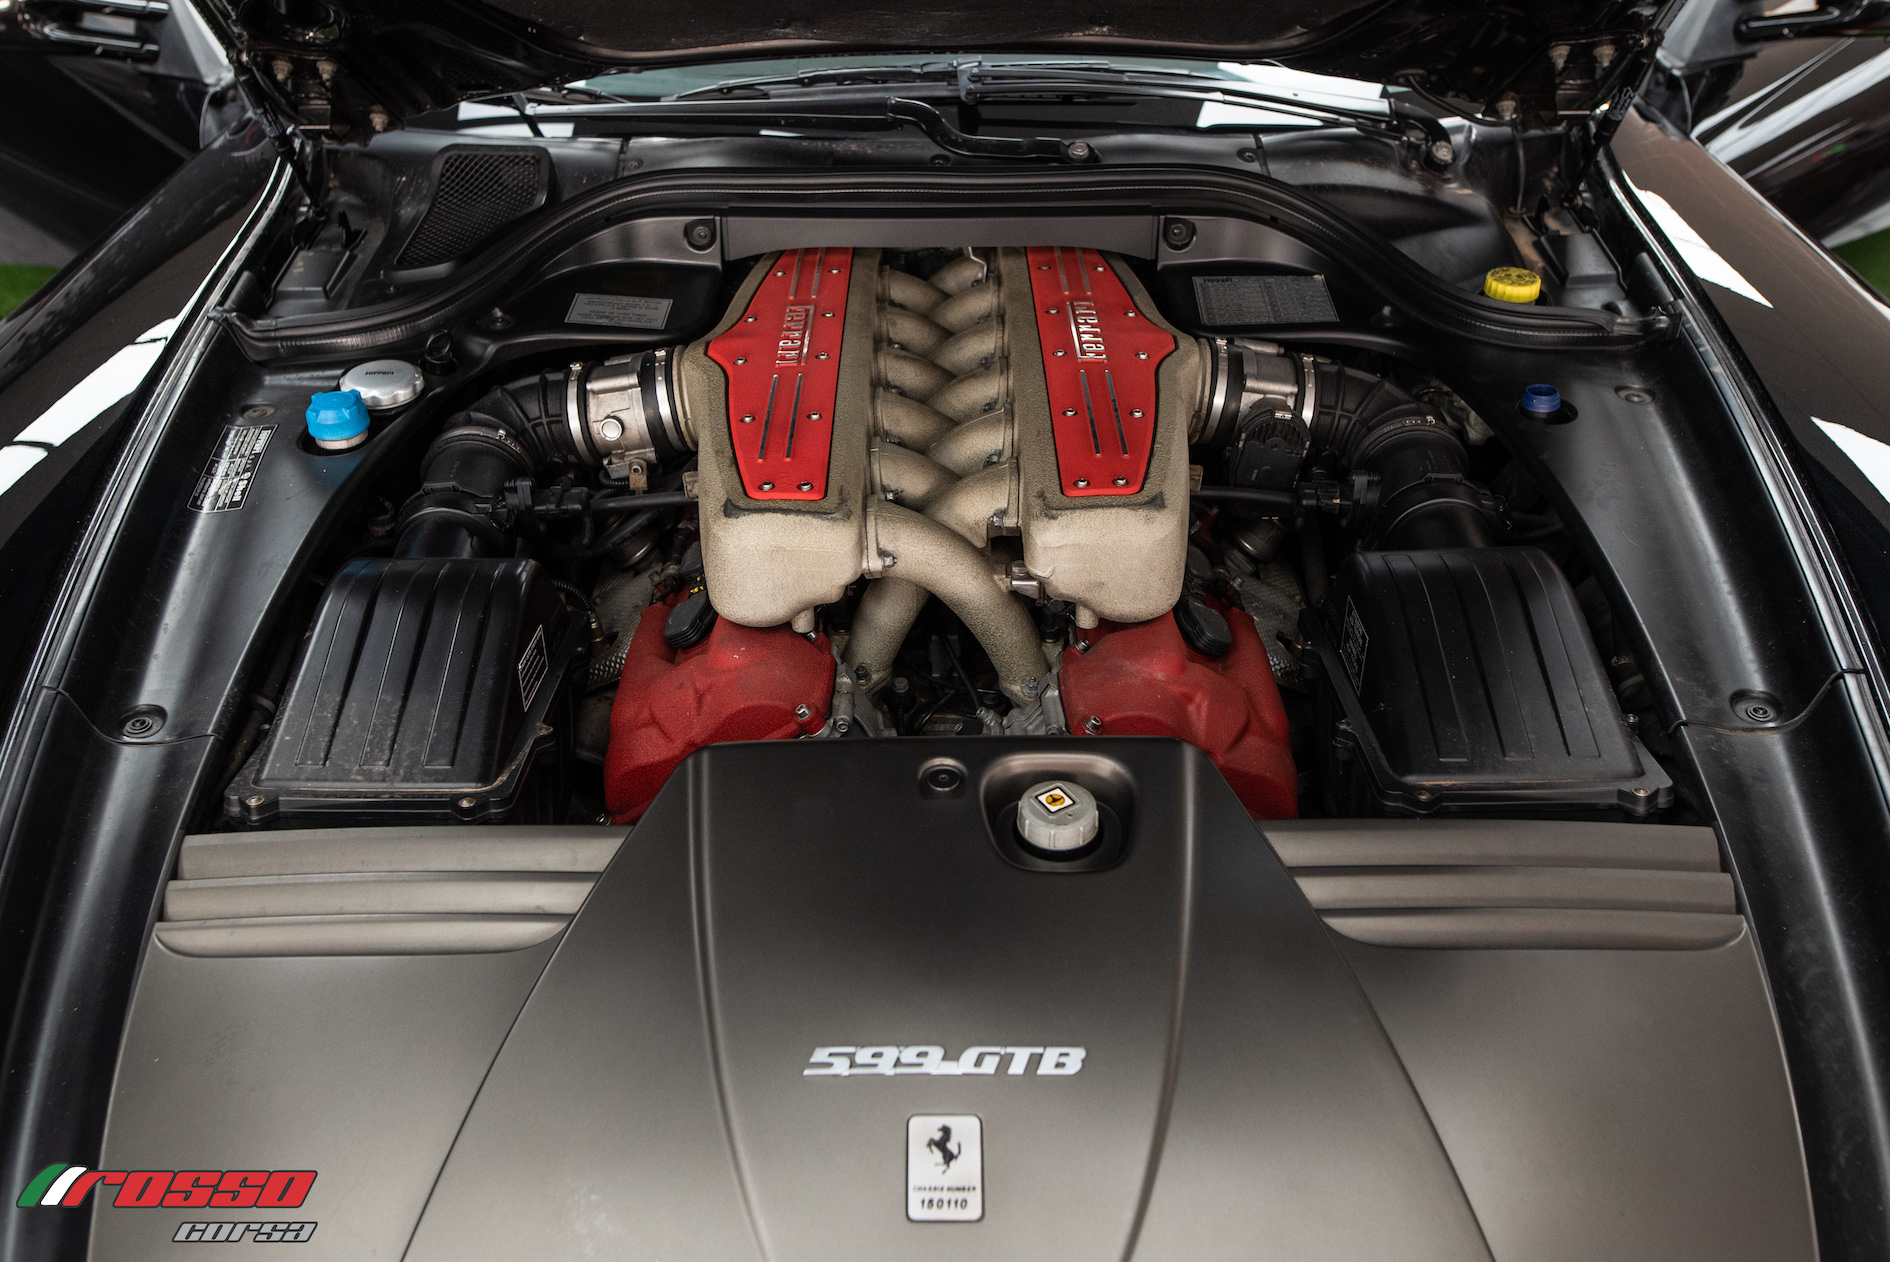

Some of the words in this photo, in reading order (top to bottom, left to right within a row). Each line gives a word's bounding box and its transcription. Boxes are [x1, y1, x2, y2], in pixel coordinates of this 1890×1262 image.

[775, 305, 814, 367] Ferrari
[1066, 301, 1107, 361] Ferrari
[231, 479, 248, 502] Shell
[958, 1045, 1087, 1076] GTB
